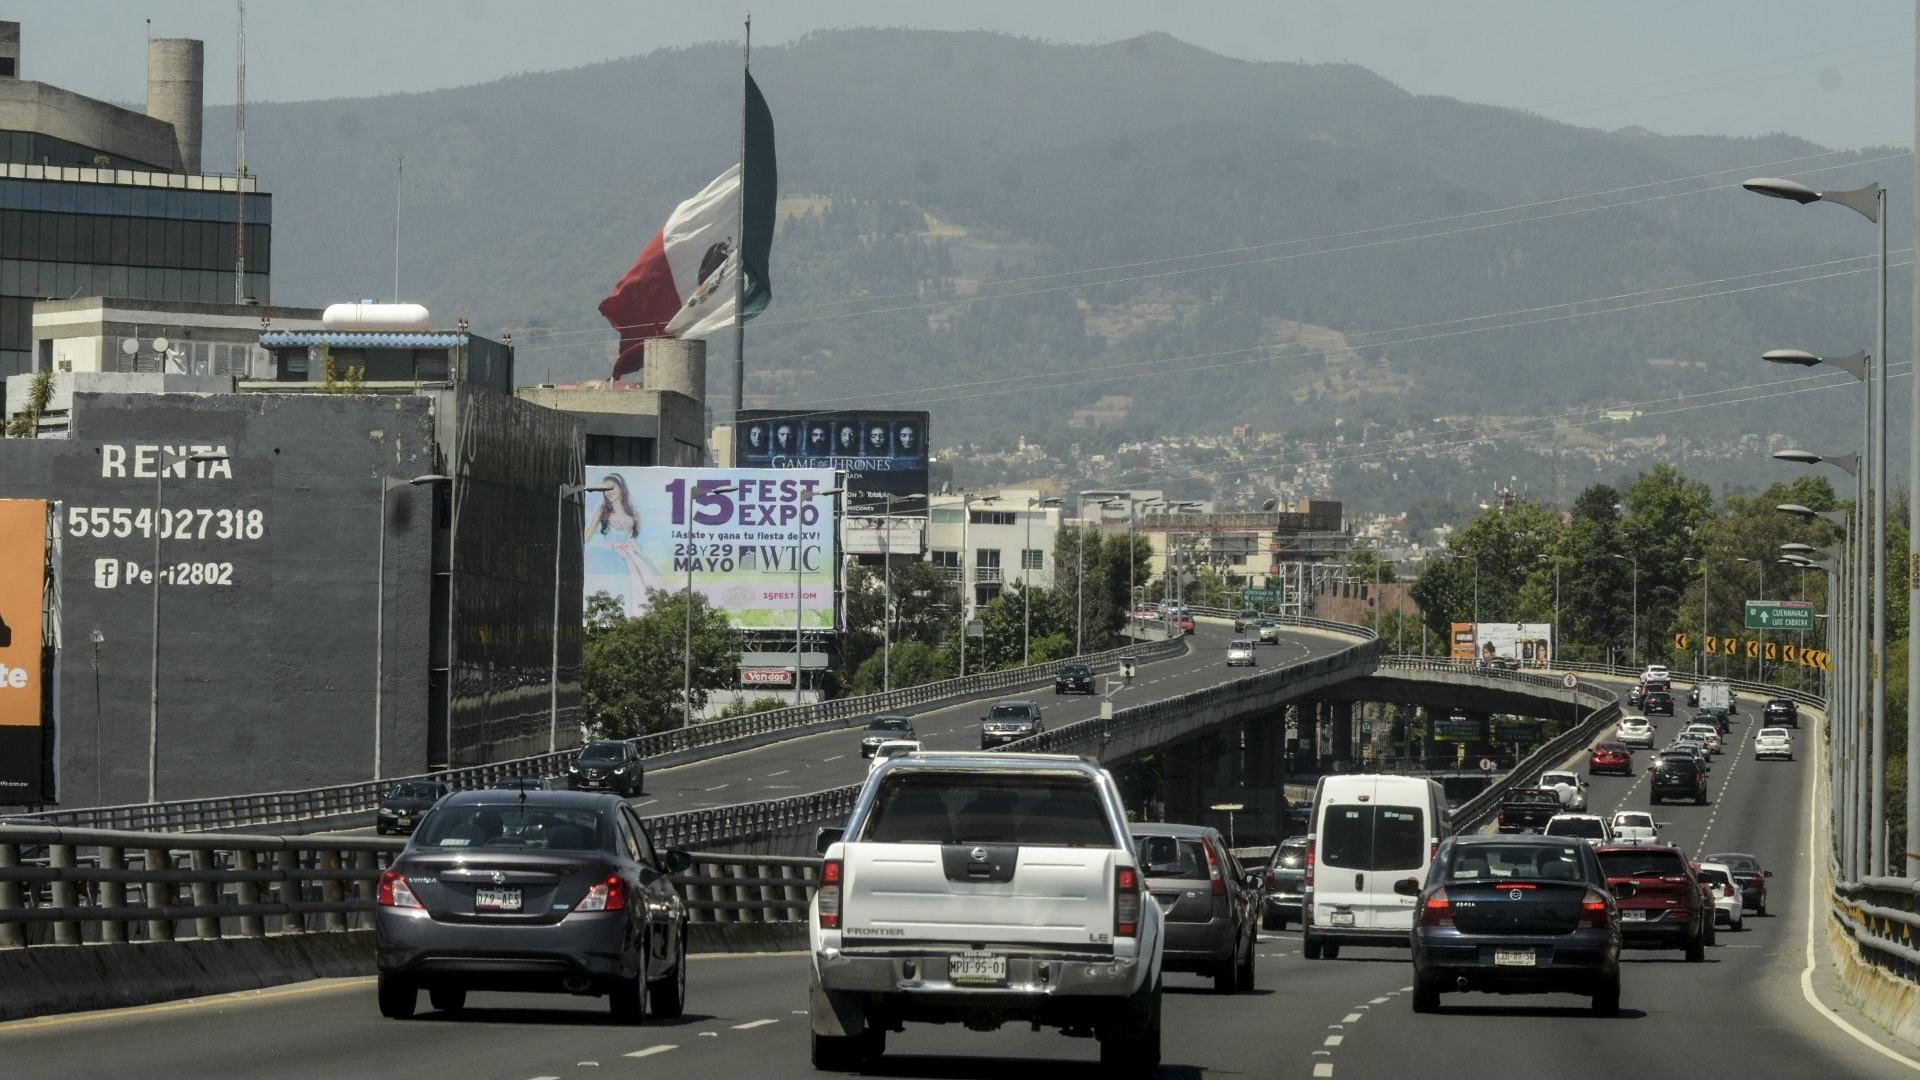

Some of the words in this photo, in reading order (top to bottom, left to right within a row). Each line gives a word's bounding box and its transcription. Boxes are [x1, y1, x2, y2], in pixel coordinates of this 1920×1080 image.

[102, 444, 233, 479] RENTA
[771, 455, 816, 469] GAME
[829, 455, 894, 471] THRONES
[665, 478, 735, 526] 15
[739, 479, 820, 502] FEST
[738, 504, 820, 526] EXPO
[69, 507, 264, 540] 5554027318
[671, 530, 706, 540] ¡Asste
[708, 532, 715, 541] y
[717, 532, 741, 541] gana
[744, 531, 754, 540] tu
[757, 530, 784, 540] fiesta
[787, 530, 798, 540] de
[673, 557, 734, 573] MAYO
[759, 545, 822, 572] WTC
[126, 562, 233, 586] Peri2802
[763, 592, 817, 600] 15FESTOM
[847, 927, 905, 936] FRONTIER
[1089, 932, 1109, 942] LE
[950, 960, 1005, 975] MPU-95-01
